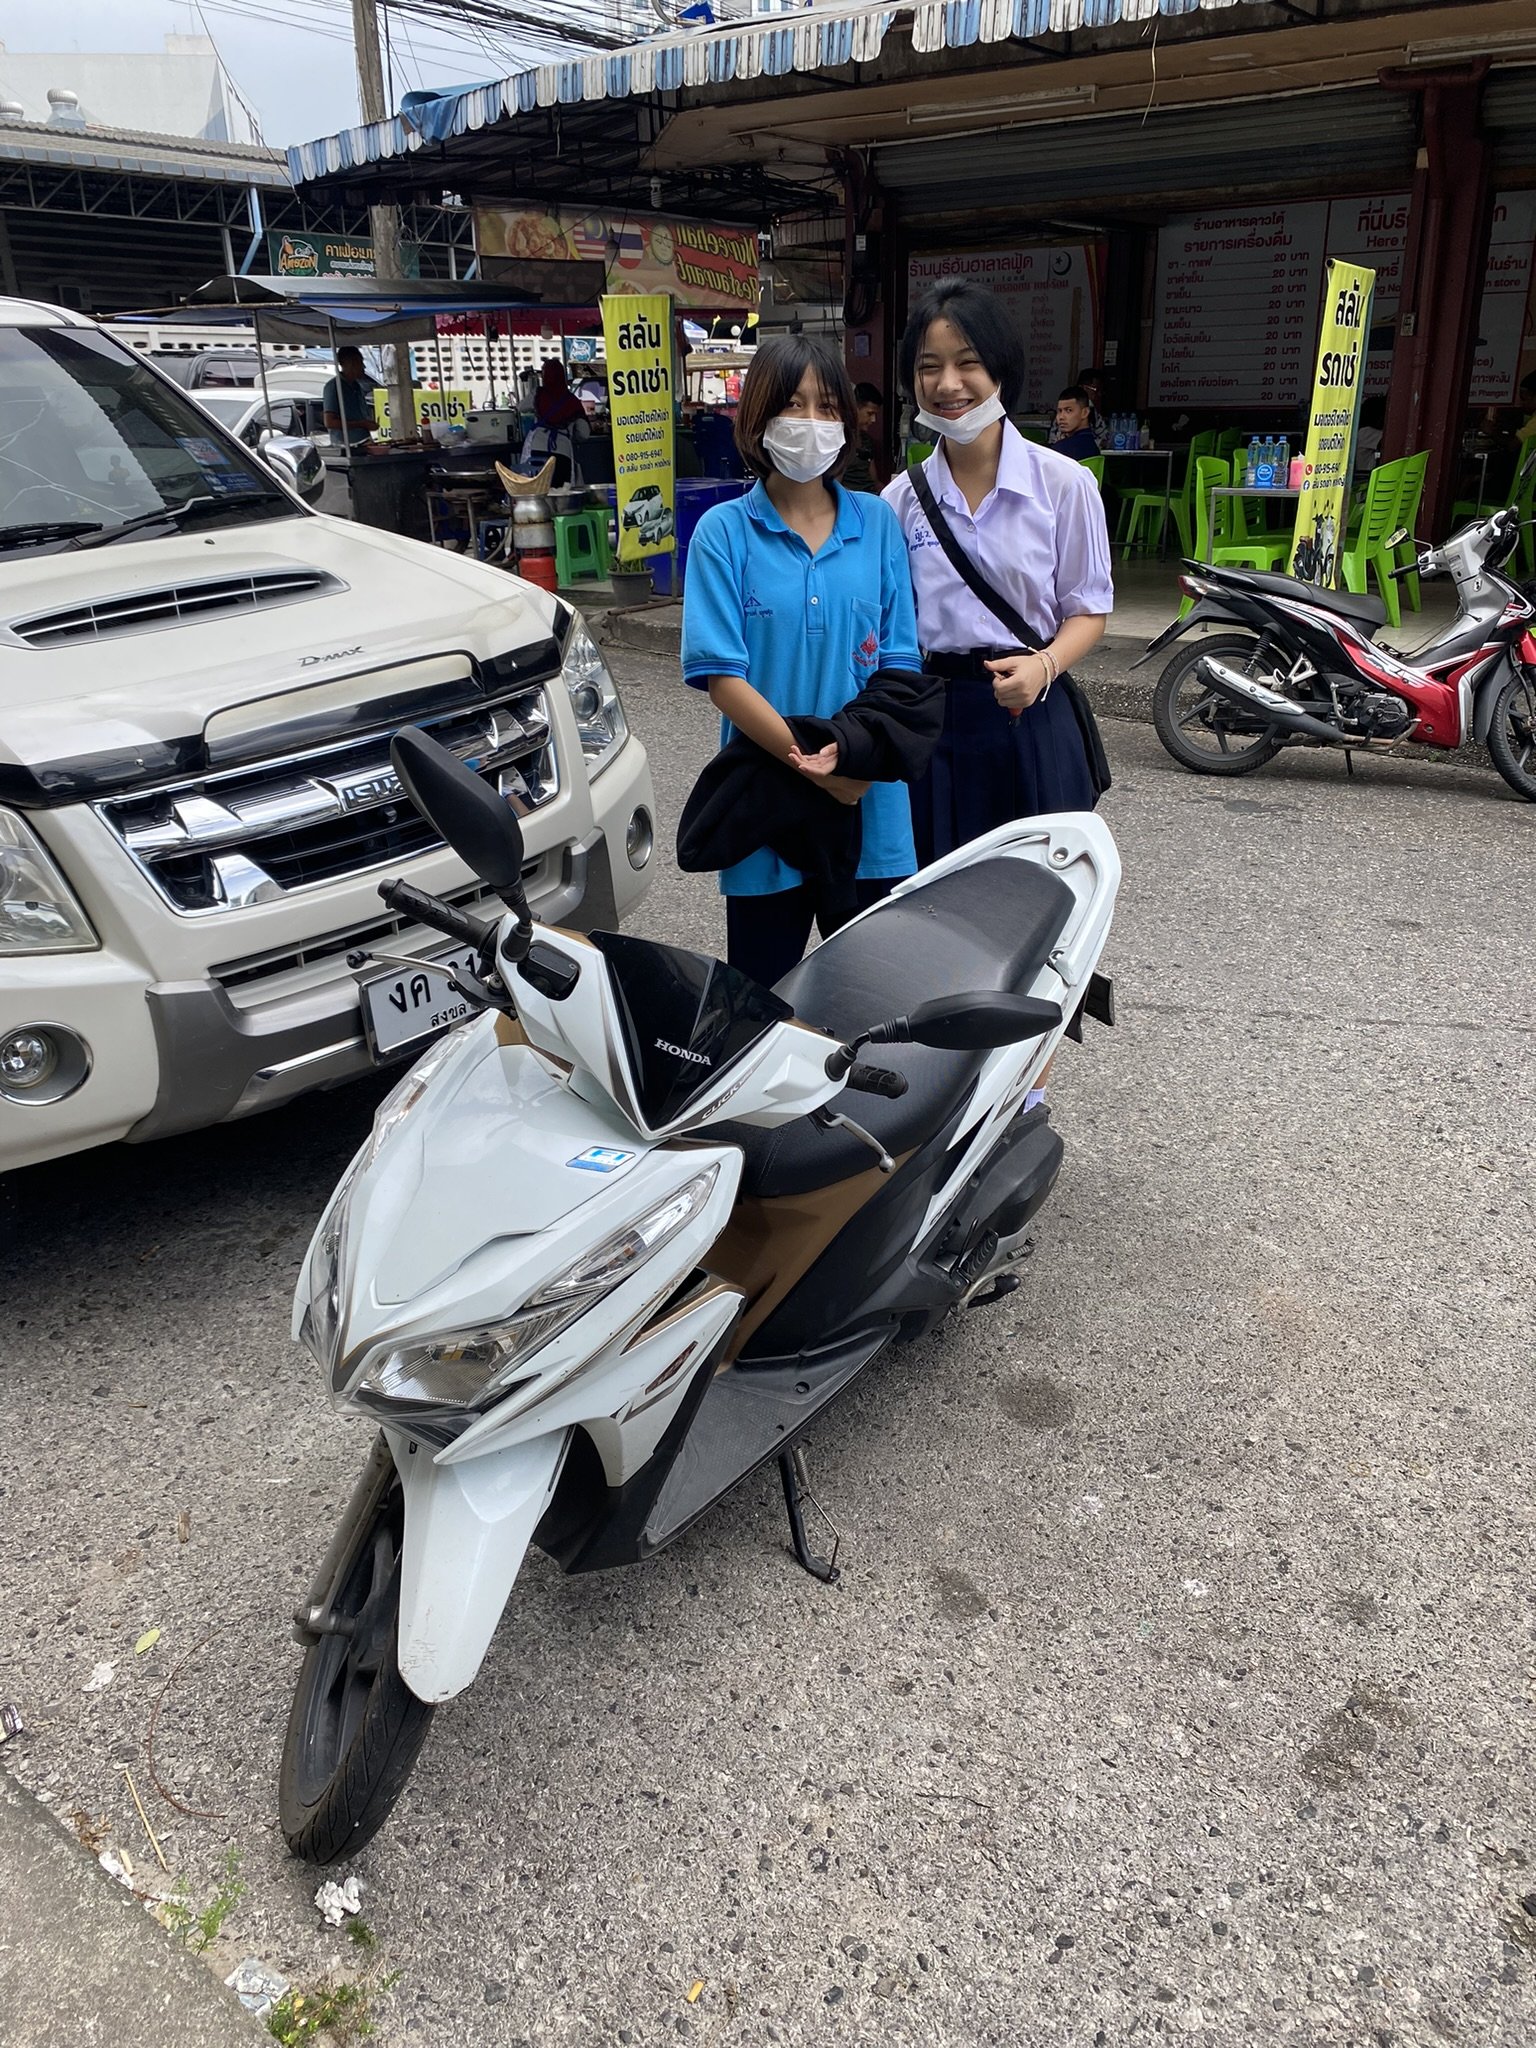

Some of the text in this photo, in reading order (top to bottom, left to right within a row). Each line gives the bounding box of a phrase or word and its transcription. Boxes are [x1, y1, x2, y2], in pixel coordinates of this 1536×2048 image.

[1184, 227, 1293, 252] รายการเครื่องดื่ม
[1366, 235, 1398, 249] Here
[1273, 253, 1287, 263] 20
[1290, 251, 1310, 261] บาท
[1272, 268, 1286, 278] 20
[1289, 267, 1308, 277] บาท
[1271, 284, 1284, 294] 20
[1287, 283, 1306, 293] บาท
[1268, 300, 1282, 310] 20
[1286, 299, 1305, 309] บาท
[1266, 315, 1280, 325] 20
[1285, 314, 1304, 324] บาท
[1265, 331, 1279, 341] 20
[1283, 330, 1302, 340] บาท
[1264, 346, 1277, 356] 20
[1282, 345, 1301, 355] บาท
[1263, 362, 1276, 371] 20
[1280, 361, 1299, 370] บาท
[612, 358, 669, 396] รถเช่า
[1261, 377, 1275, 386] 20
[1279, 376, 1298, 385] บาท
[1260, 391, 1273, 401] 20
[1278, 391, 1297, 400] บาท
[420, 396, 466, 418] รถช่า
[345, 775, 405, 803] ISUZ
[388, 973, 432, 1013] งค
[430, 1002, 468, 1028] สงขล
[653, 1037, 713, 1067] HONDA
